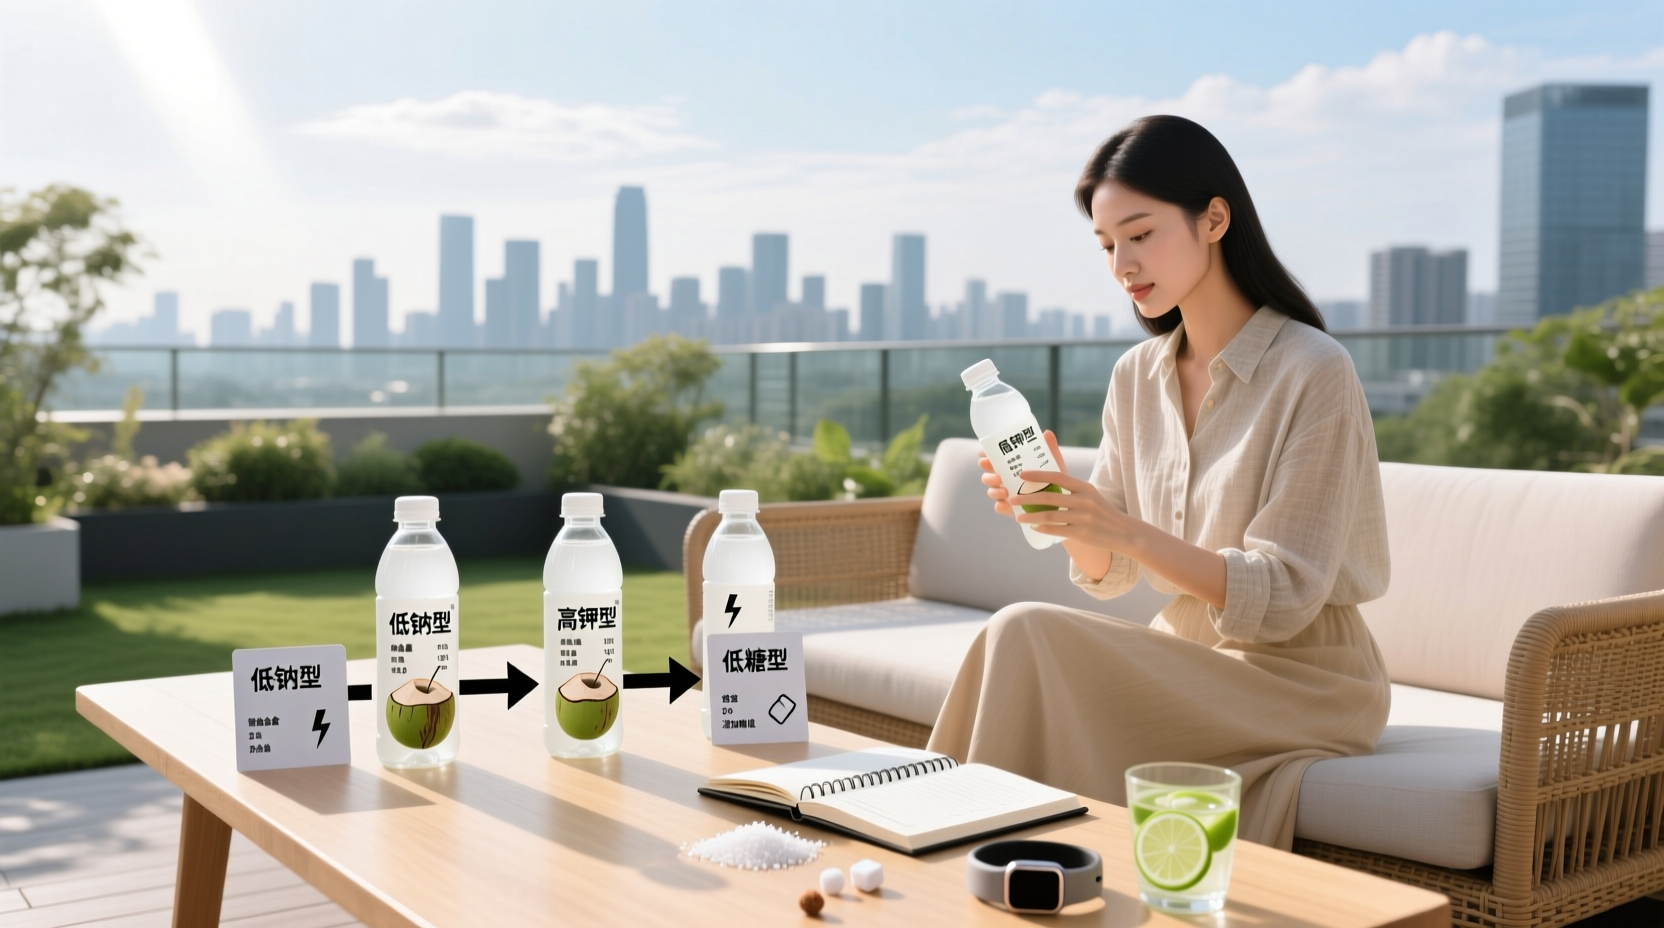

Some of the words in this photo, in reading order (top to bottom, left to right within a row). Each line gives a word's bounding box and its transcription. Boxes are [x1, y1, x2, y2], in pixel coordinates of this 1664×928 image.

[389, 611, 451, 635] 低钠型
[557, 606, 616, 631] 高钾型
[722, 647, 788, 673] 低糖型
[251, 664, 322, 692] 低钠型
